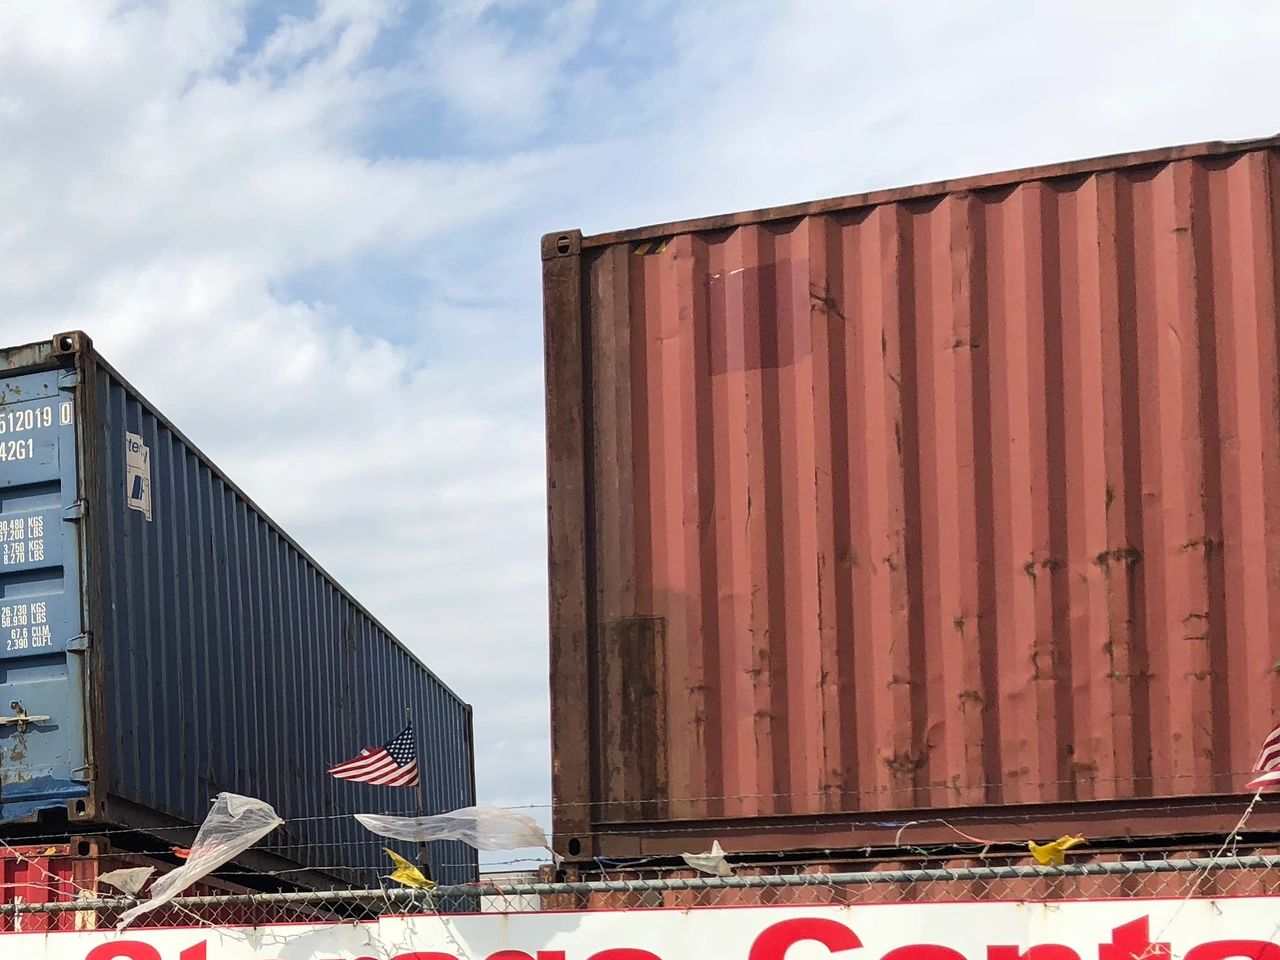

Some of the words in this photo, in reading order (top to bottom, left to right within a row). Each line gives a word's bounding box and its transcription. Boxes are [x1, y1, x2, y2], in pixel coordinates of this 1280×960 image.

[60, 403, 71, 425] 0
[28, 516, 43, 528] KGS
[28, 527, 43, 538] LBS
[28, 539, 44, 551] KGS
[3, 553, 24, 565] 8.270
[29, 550, 44, 562] LBS
[1, 604, 27, 617] 26.730
[30, 602, 46, 613] KGS
[31, 613, 46, 624] LBS
[11, 628, 28, 640] 67.6
[7, 638, 28, 651] 2.390
